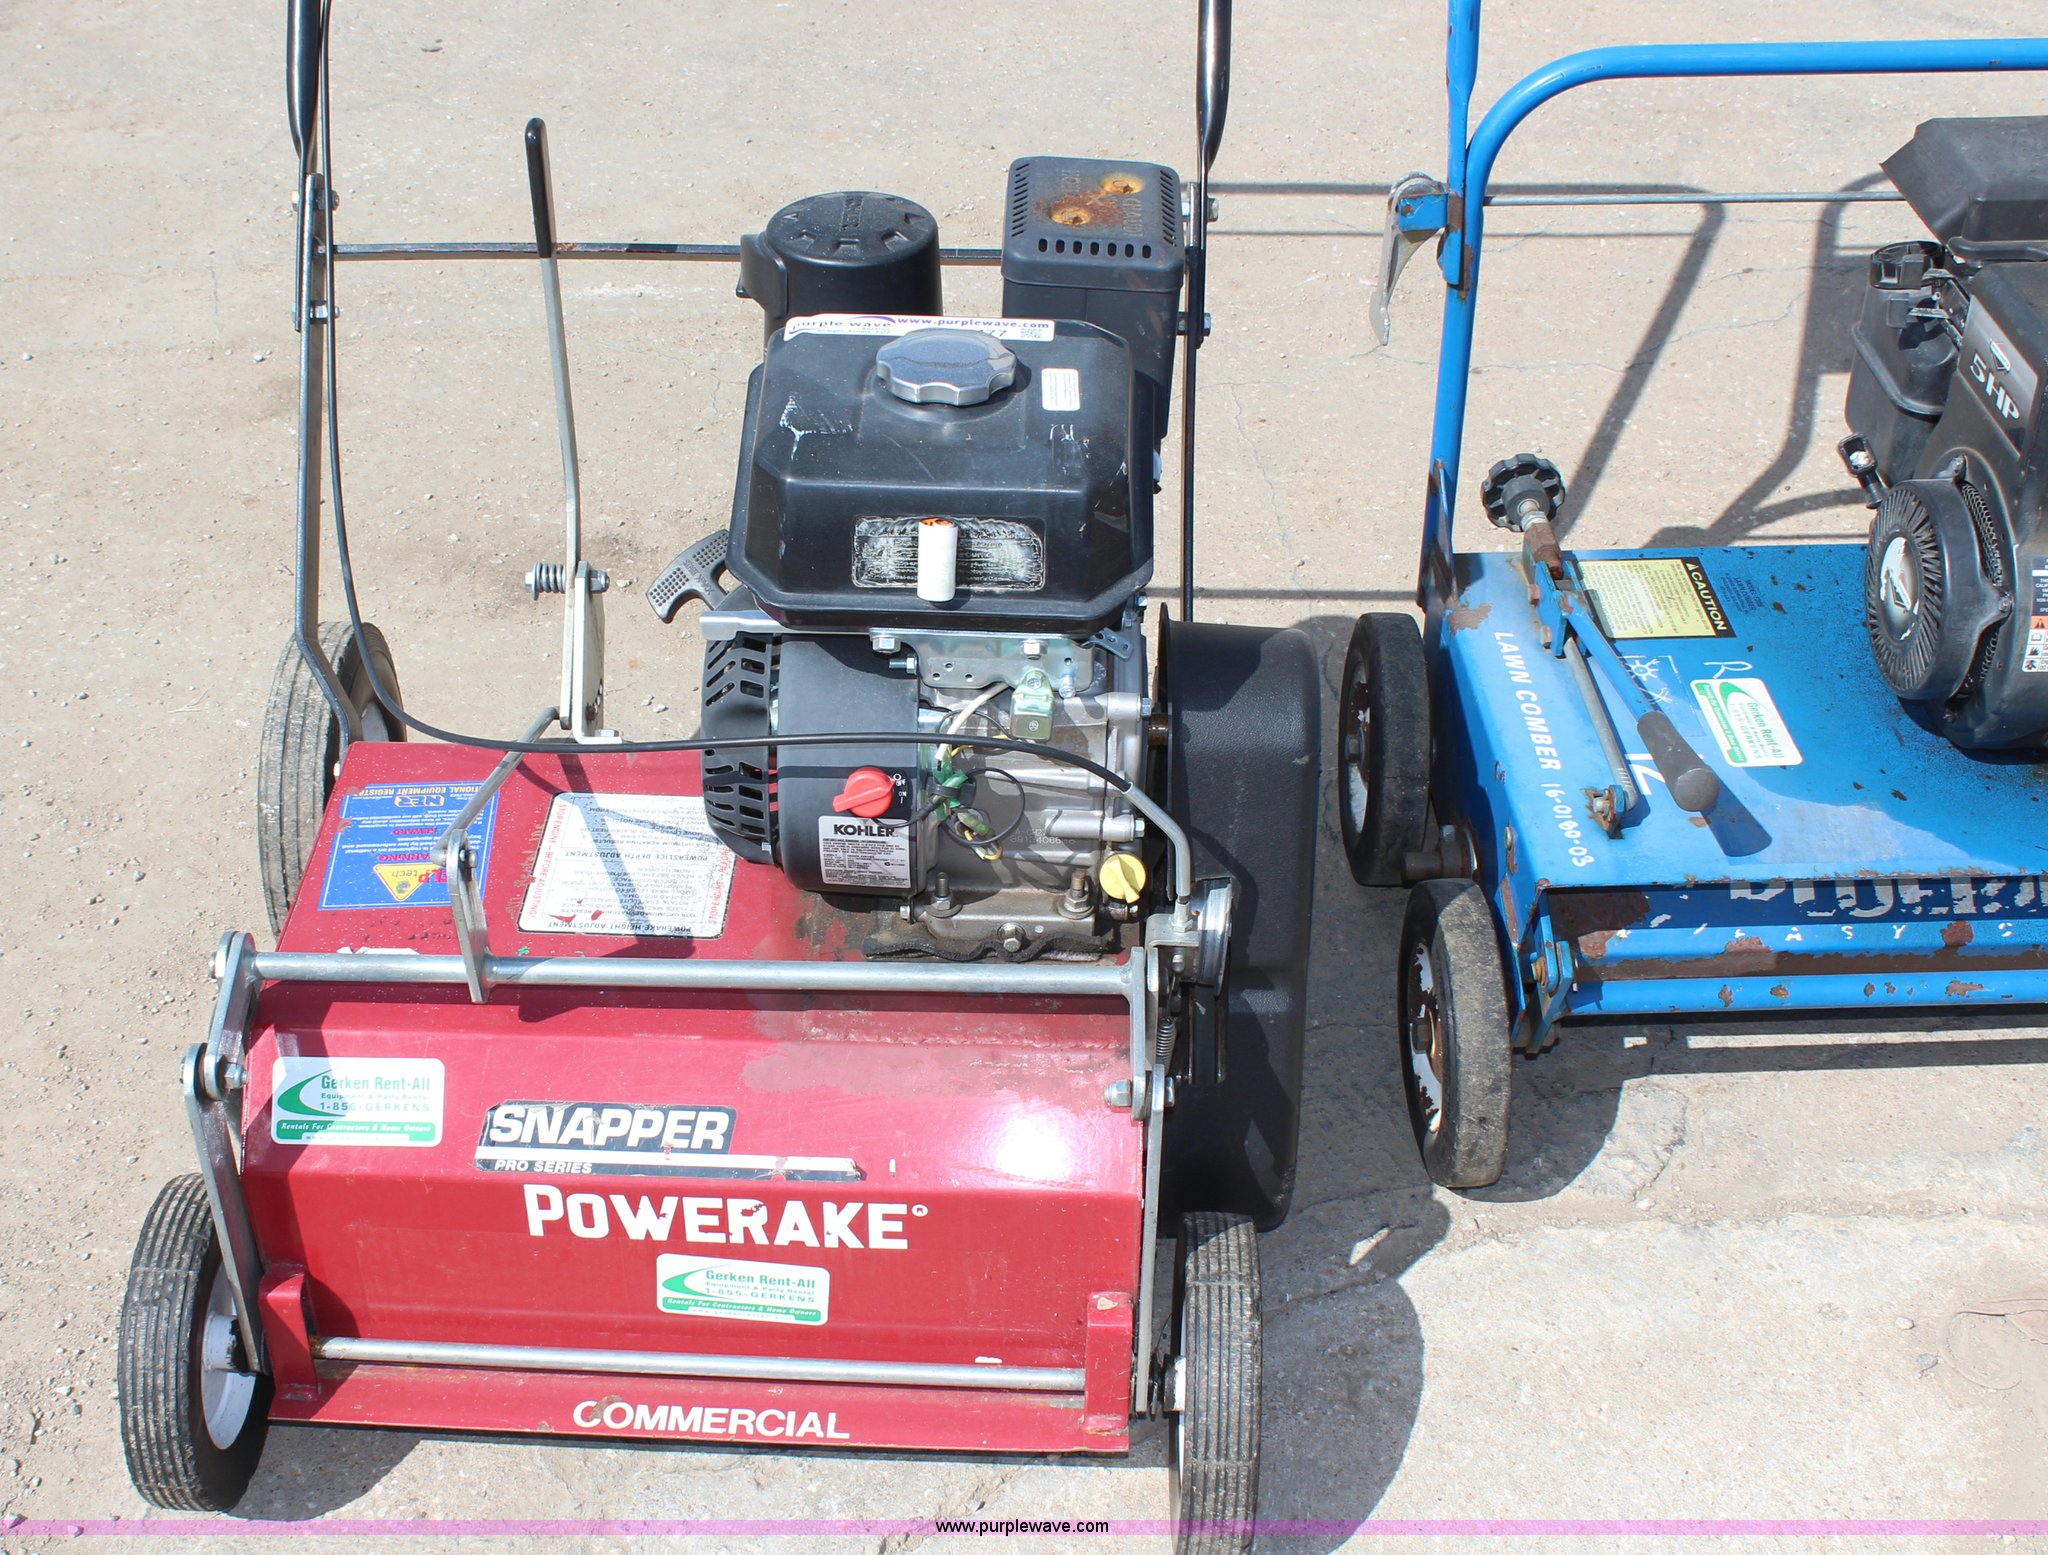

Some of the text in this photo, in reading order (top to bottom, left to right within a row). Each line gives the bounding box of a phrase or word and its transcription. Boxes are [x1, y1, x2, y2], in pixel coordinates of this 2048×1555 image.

[792, 320, 892, 331] purple wave
[897, 316, 1050, 330] www.purplewave.com
[1969, 352, 2021, 419] 5HP
[1691, 571, 1728, 631] CAUTION
[1493, 630, 1533, 684] LAWN
[1515, 689, 1563, 771] COMBER
[1747, 702, 1785, 758] Gerken Rent-All
[396, 786, 447, 795] EQUIPMENT
[898, 790, 907, 798] ON
[833, 823, 895, 837] KOHLER
[378, 853, 431, 862] ARNING
[564, 850, 708, 862] POWERSLICE DEPTH ADJUSTMENT
[391, 870, 418, 879] tech
[547, 921, 606, 931] ADJUSTMENT
[609, 922, 643, 932] HEIGHT
[321, 1075, 431, 1091] Gerken Rent-All
[281, 1122, 309, 1131] Rentals
[312, 1122, 324, 1131] For
[489, 1104, 731, 1150] SNAPPER
[494, 1159, 593, 1174] PRO SERIES
[523, 1183, 909, 1250] POWERAKE
[705, 1269, 816, 1289] Gerken Rent-All
[667, 1298, 696, 1307] Rentals
[698, 1299, 710, 1307] For
[712, 1301, 756, 1311] Contractors
[766, 1306, 787, 1315] Home
[789, 1308, 817, 1317] Owners
[572, 1399, 851, 1440] COMMERCIAL
